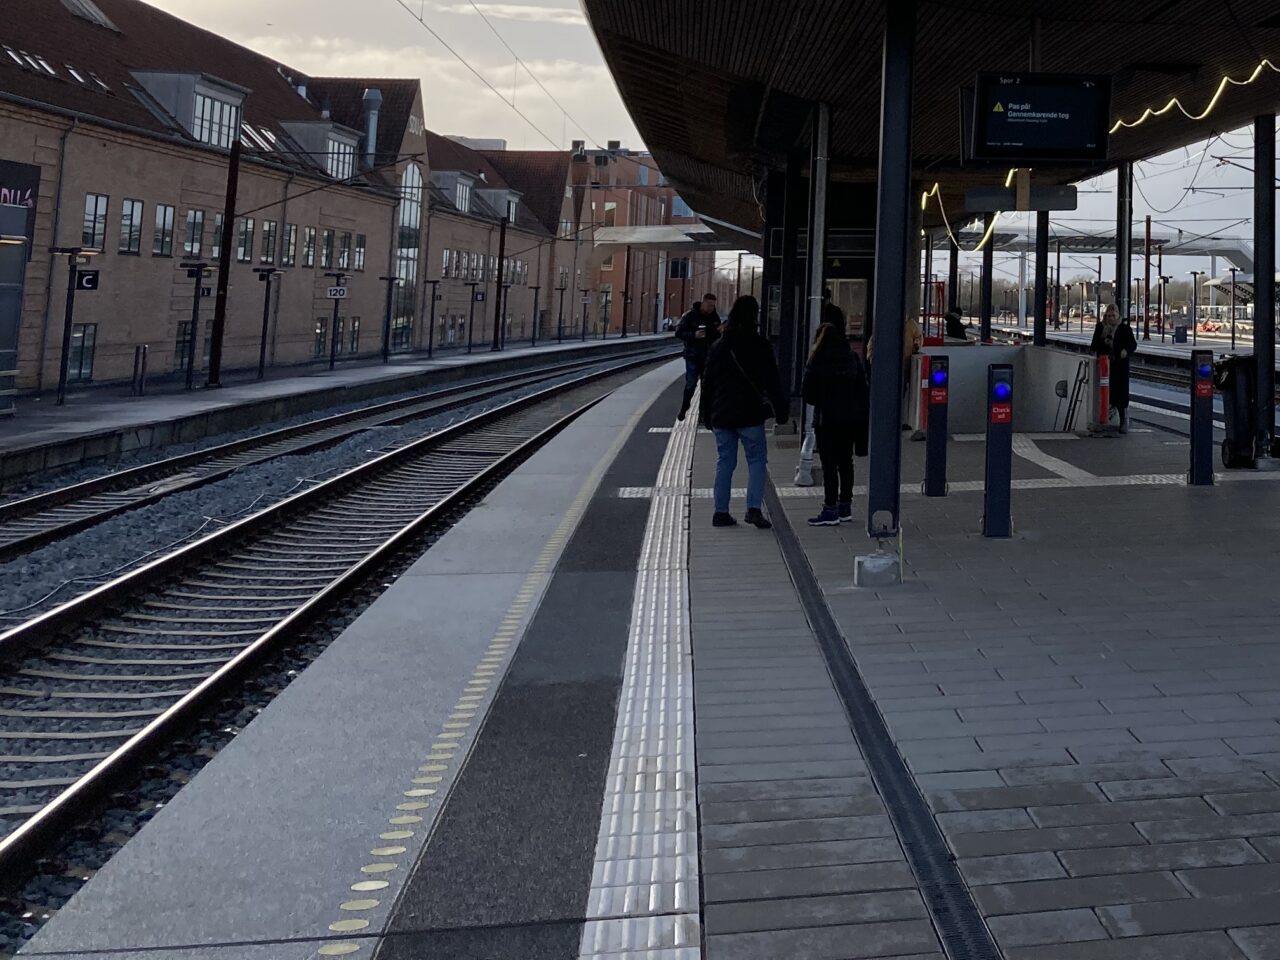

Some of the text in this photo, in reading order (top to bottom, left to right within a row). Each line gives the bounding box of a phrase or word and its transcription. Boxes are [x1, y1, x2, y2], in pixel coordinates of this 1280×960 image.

[1000, 77, 1014, 85] Spor
[1058, 112, 1070, 120] tog
[82, 275, 93, 288] C
[329, 288, 345, 297] 120
